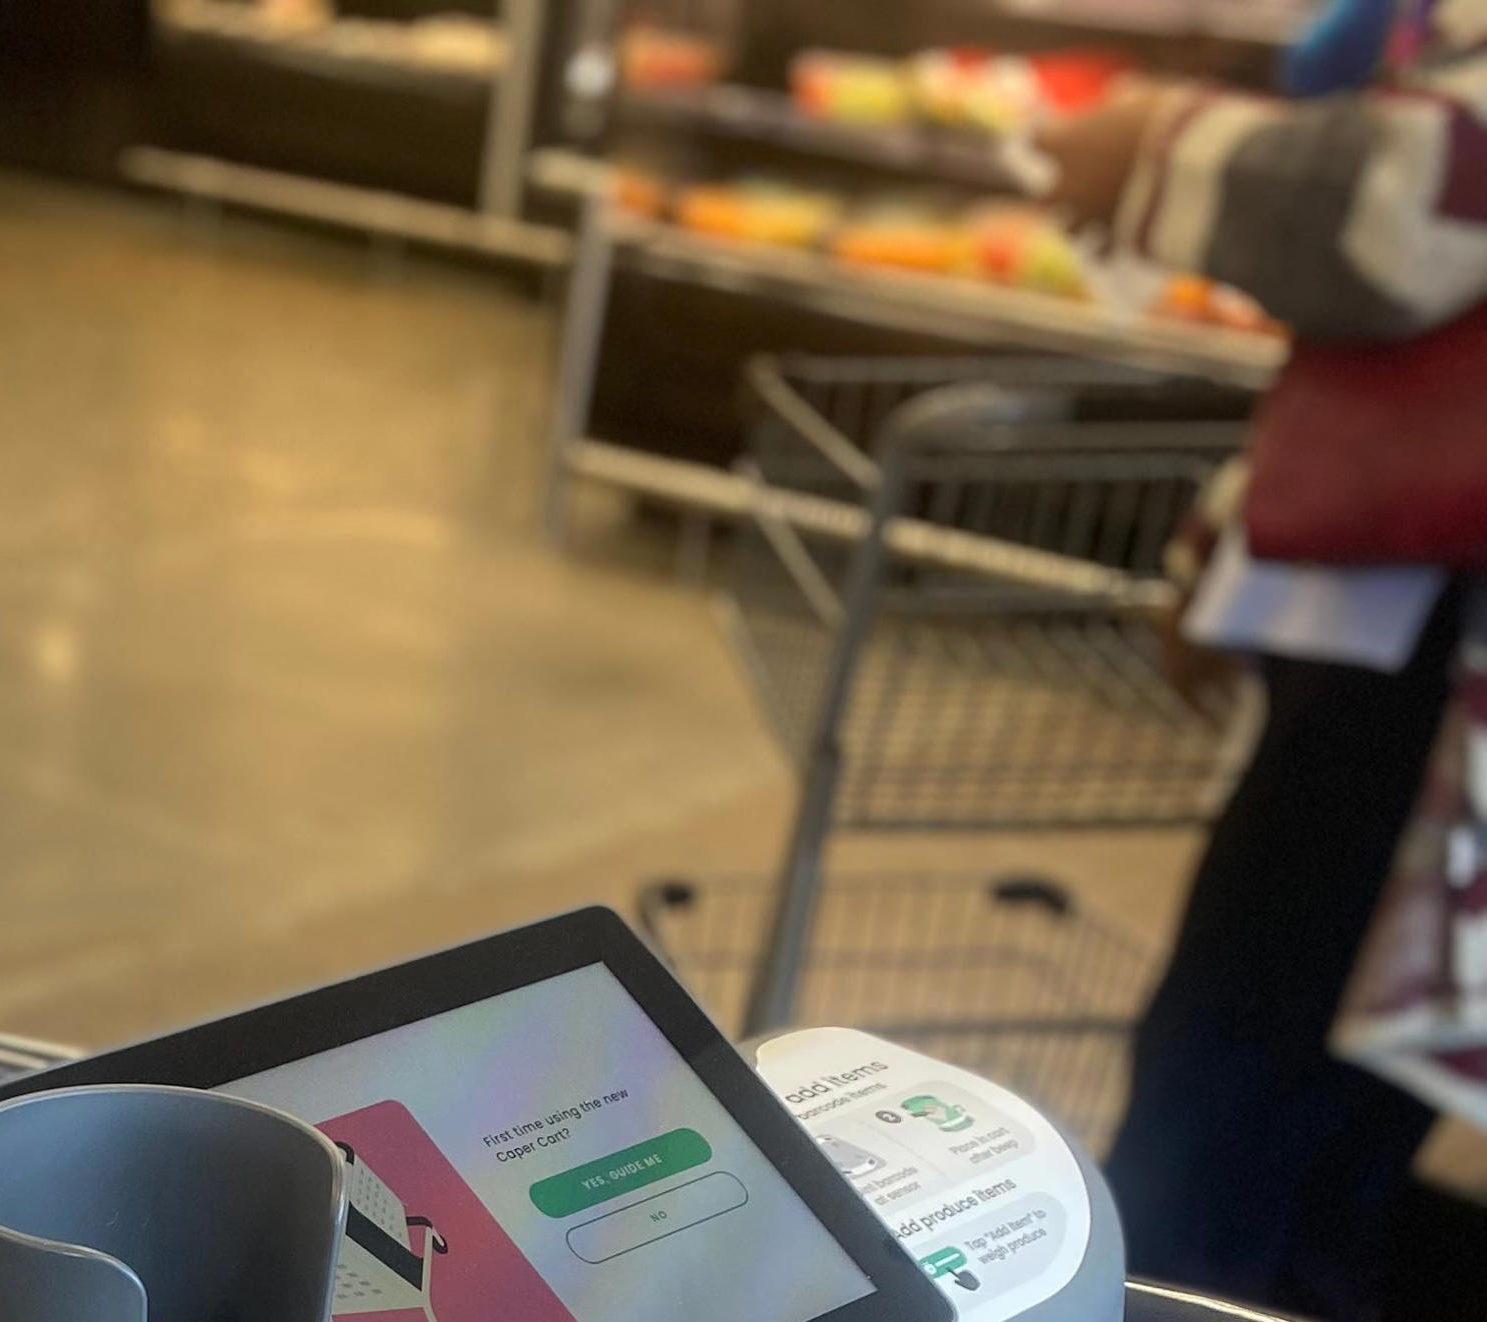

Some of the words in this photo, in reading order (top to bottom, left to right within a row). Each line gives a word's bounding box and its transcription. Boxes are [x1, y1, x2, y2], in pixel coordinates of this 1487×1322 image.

[785, 1080, 832, 1104] add
[483, 1130, 514, 1148] First
[513, 1119, 544, 1137] time
[544, 1105, 582, 1126] using
[580, 1097, 602, 1114] the
[603, 1088, 629, 1105] new
[496, 1140, 538, 1163] Caper
[536, 1127, 571, 1148] Cart?
[581, 1174, 612, 1191] YES,
[608, 1160, 645, 1181] GUIDE
[644, 1153, 663, 1168] ME
[649, 1210, 668, 1223] NO
[920, 1195, 980, 1232] produce
[973, 1178, 1018, 1202] items
[964, 1236, 988, 1252] Tap
[1031, 1209, 1047, 1220] to
[977, 1244, 1009, 1265] weigh
[1007, 1227, 1048, 1255] produce
